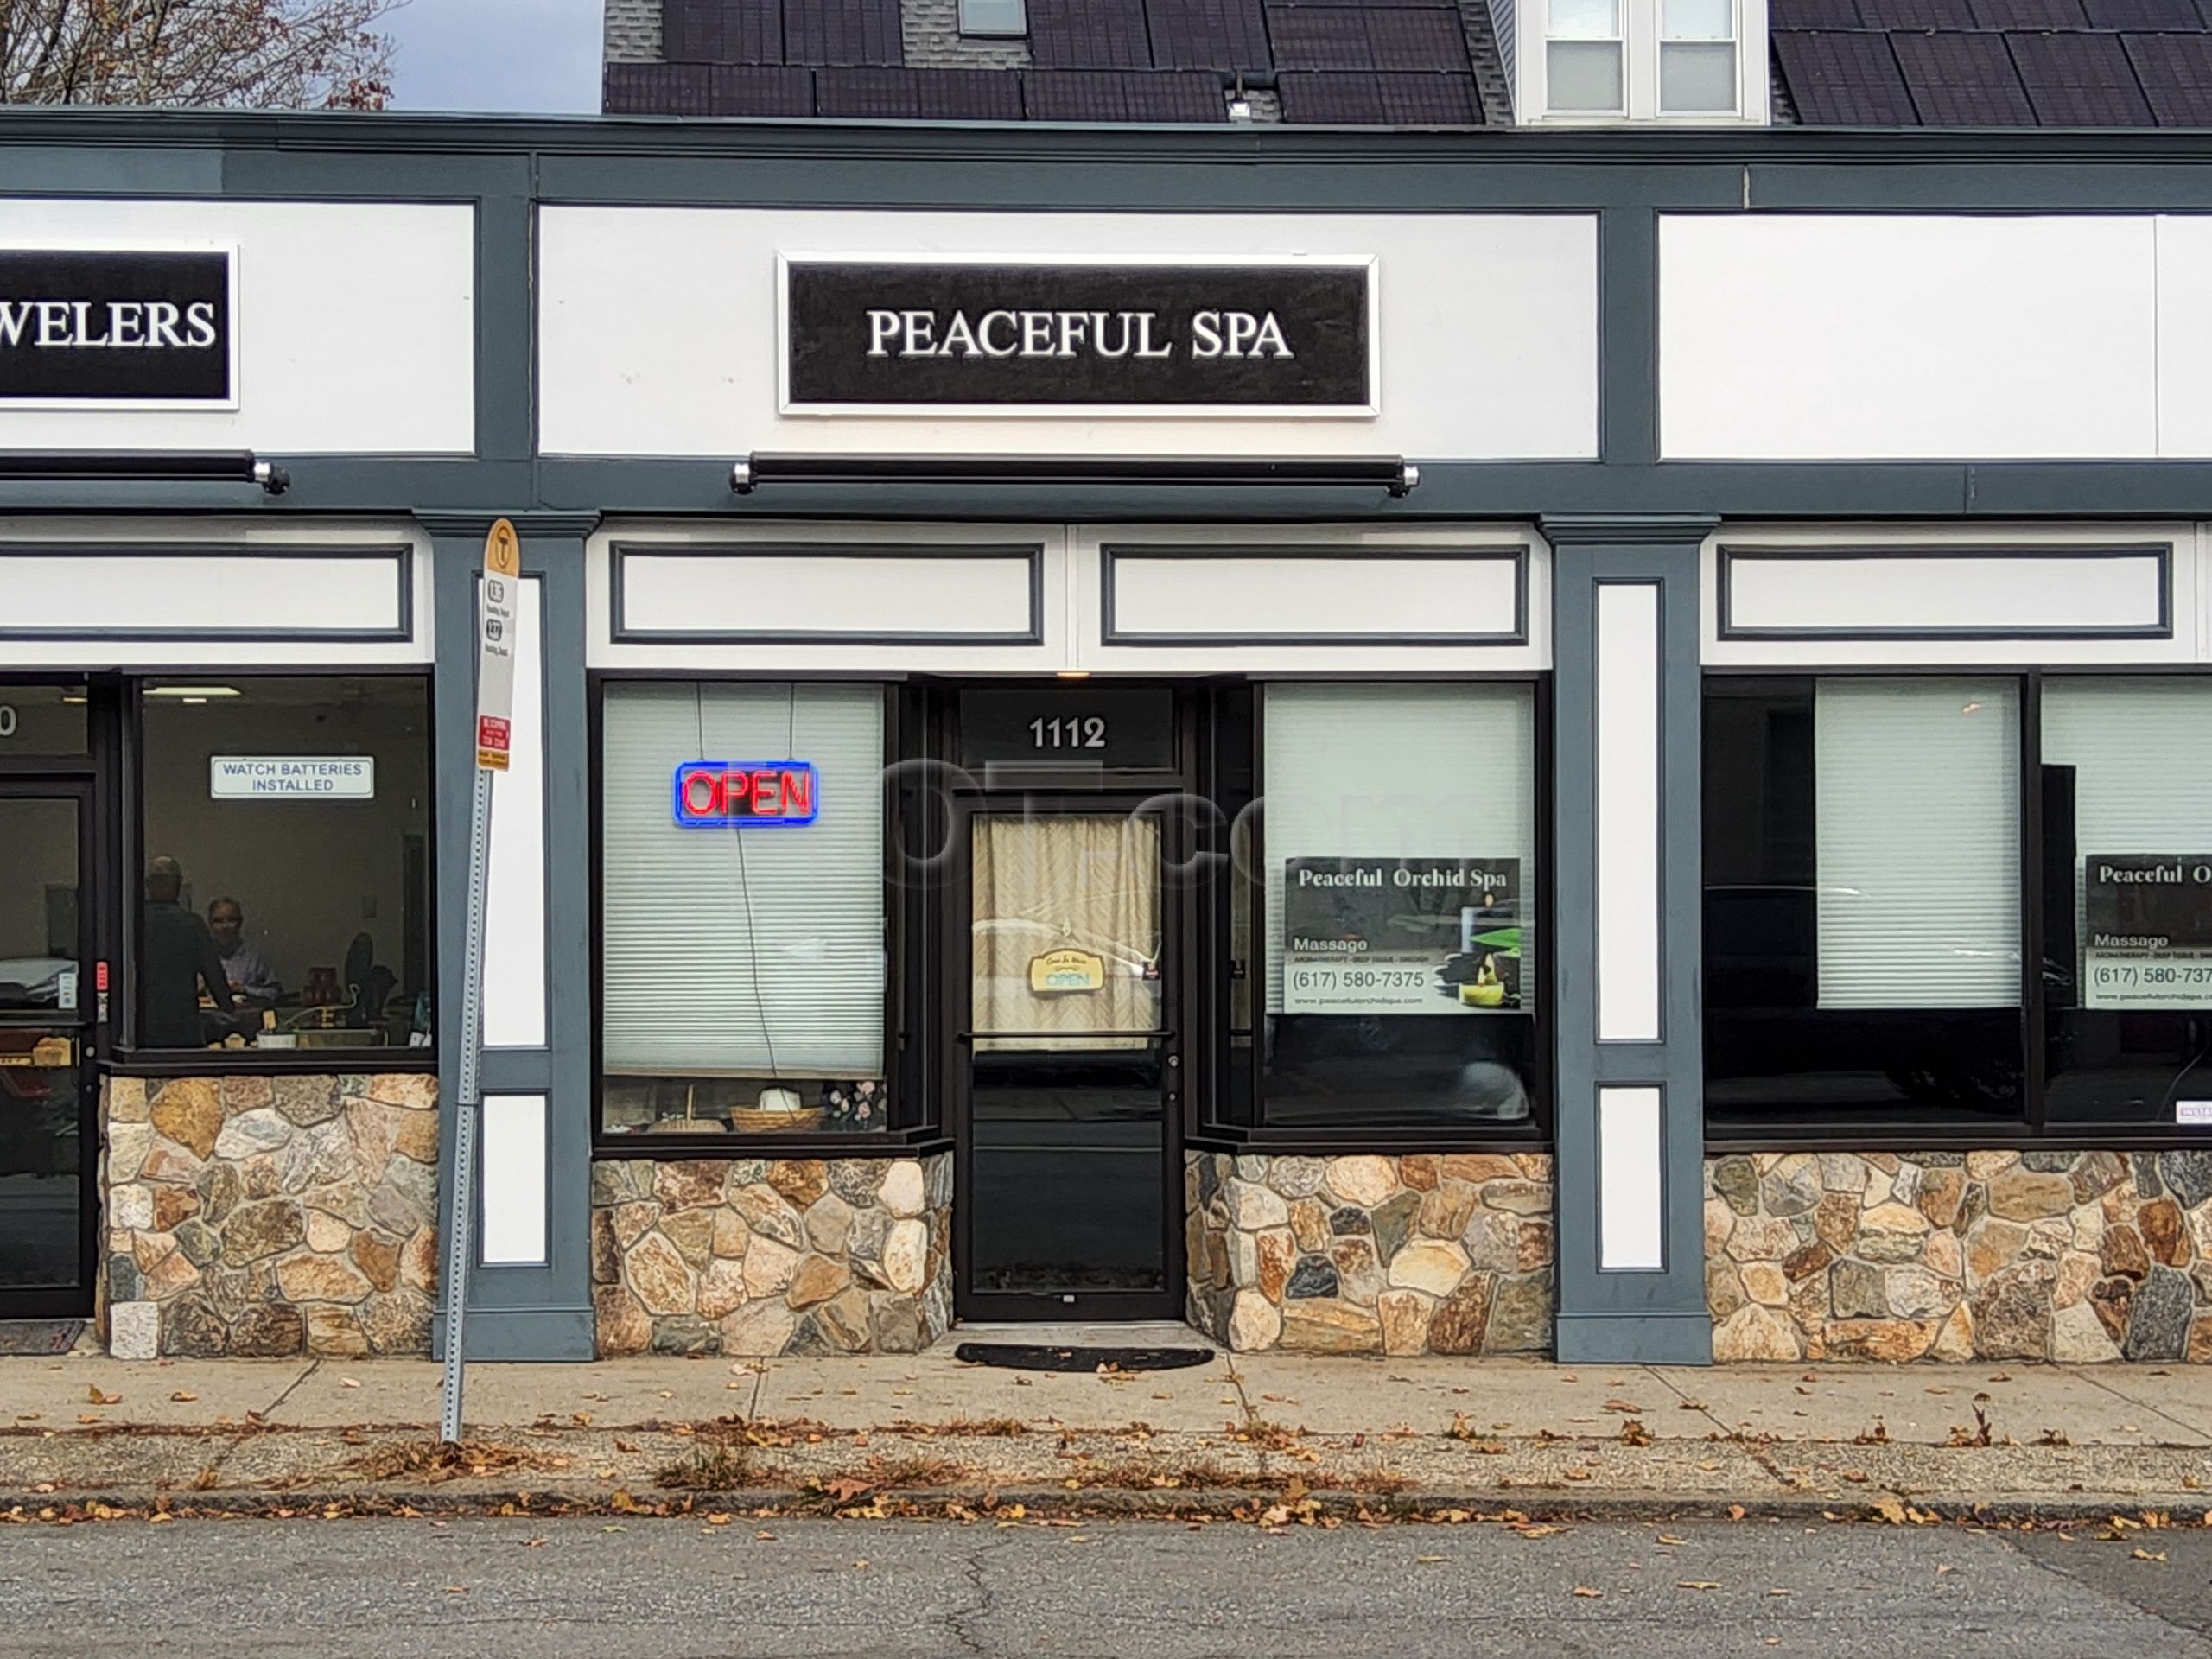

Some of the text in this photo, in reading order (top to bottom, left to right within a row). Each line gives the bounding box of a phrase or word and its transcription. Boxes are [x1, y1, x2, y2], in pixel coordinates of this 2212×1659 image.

[867, 309, 1294, 359] PEACEFUL SPA
[1029, 716, 1105, 748] 1112
[223, 763, 363, 776] WATCH BATTERIES
[252, 779, 334, 791] INSTALLED
[682, 769, 810, 816] OPEN
[1299, 868, 1507, 891] Peaceful Orchid Spa
[2100, 865, 2183, 884] Peaceful
[1294, 938, 1368, 954] Massage
[2094, 933, 2169, 950] Massage
[1045, 972, 1090, 987] OPEN
[1293, 970, 1425, 991] (617) 580-7375
[2094, 967, 2212, 988] (617) 580-737
